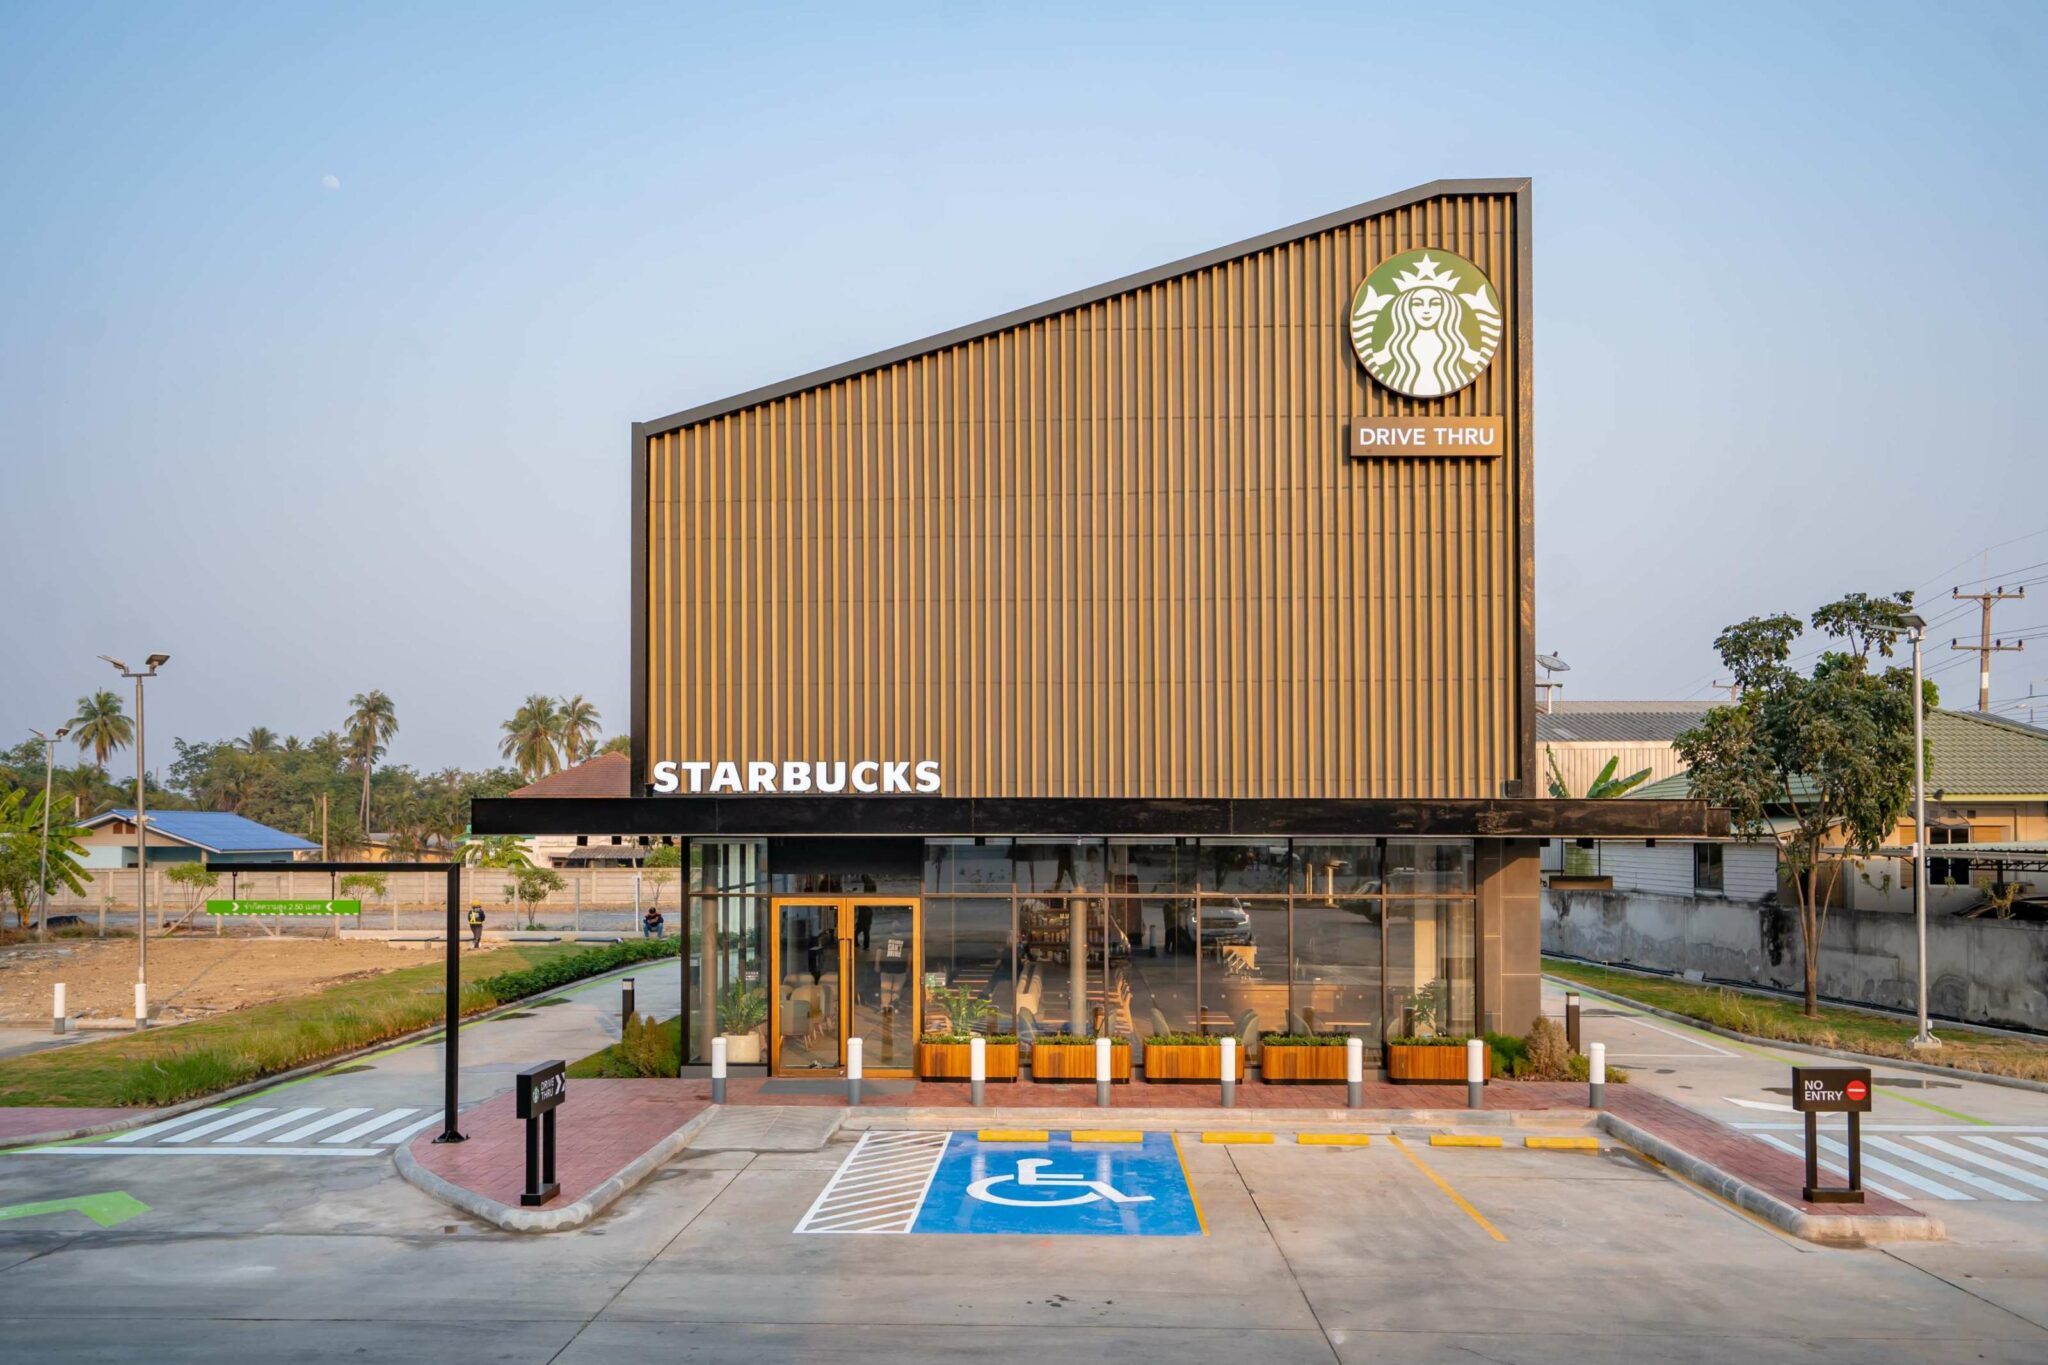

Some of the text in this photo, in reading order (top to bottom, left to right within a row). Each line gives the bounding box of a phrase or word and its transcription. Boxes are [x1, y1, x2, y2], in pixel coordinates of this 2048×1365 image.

[1359, 427, 1495, 446] DRIVE THRU
[653, 761, 941, 793] STARBUCKS
[540, 1076, 555, 1092] DRIVE
[1804, 1079, 1824, 1091] NO
[540, 1087, 554, 1101] THRU
[1804, 1090, 1843, 1101] ENTRY
